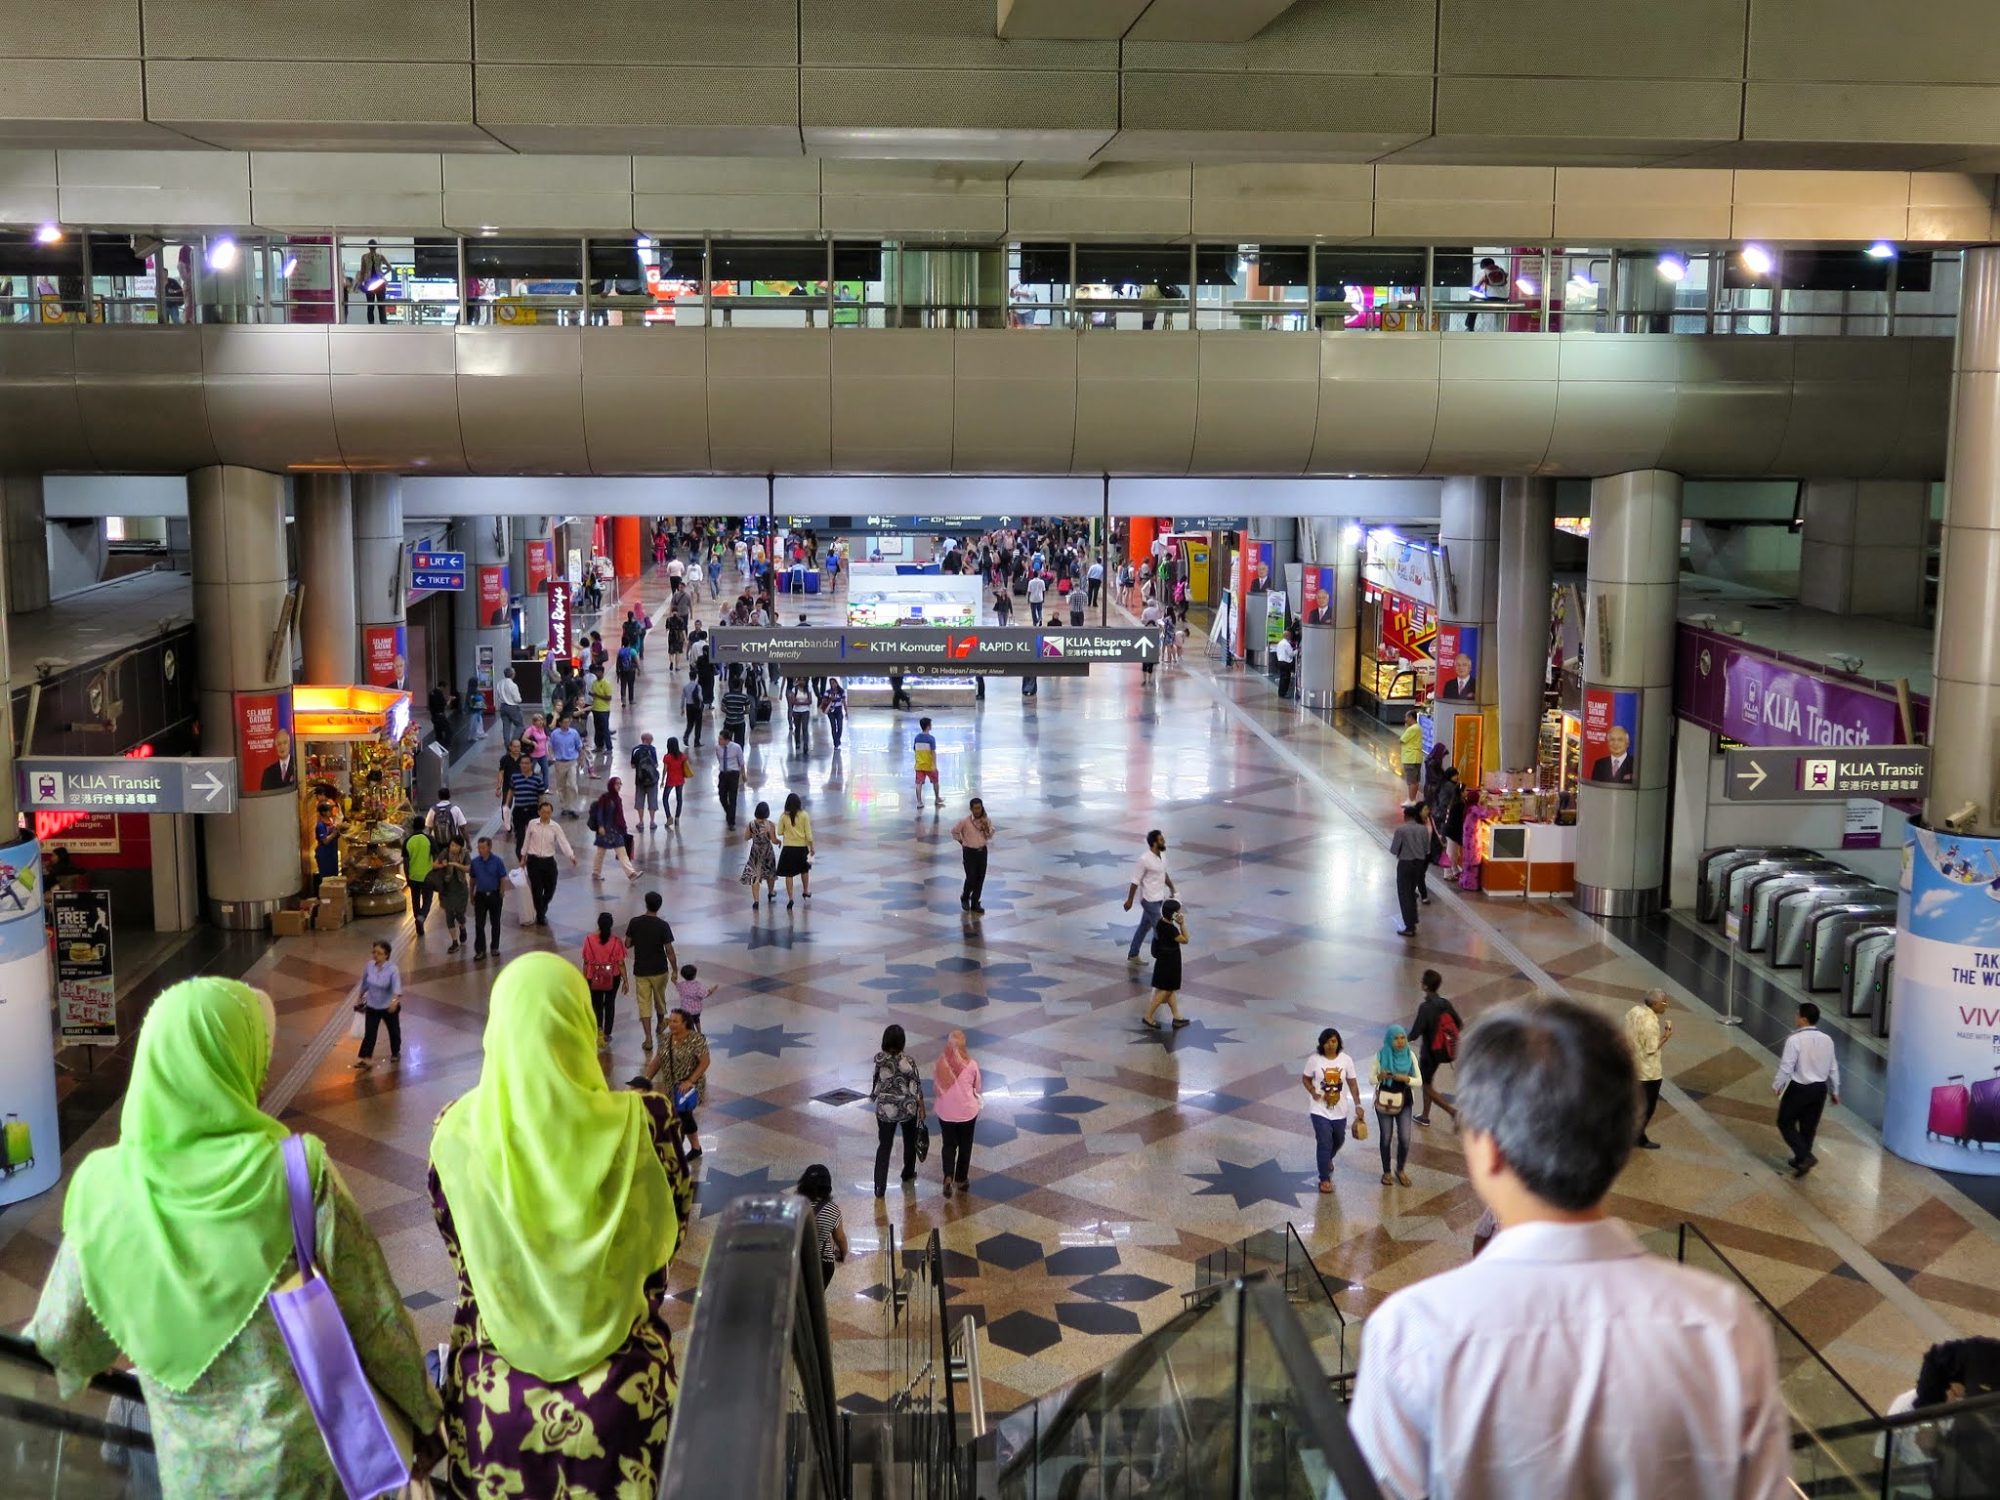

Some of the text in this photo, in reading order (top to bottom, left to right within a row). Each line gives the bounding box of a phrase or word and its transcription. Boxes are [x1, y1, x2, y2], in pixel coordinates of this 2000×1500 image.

[429, 557, 446, 566] LRT
[427, 576, 450, 584] TIKET
[741, 637, 840, 653] KTM Antarabandar
[870, 642, 946, 652] KTM Komuter
[979, 641, 1014, 652] RAPID
[1016, 641, 1031, 652] KL
[1065, 637, 1132, 649] KLIA Ekspres
[768, 650, 801, 659] Intercity
[1762, 689, 1870, 746] KLIA Transit
[1839, 762, 1925, 777] KLIA Transit
[68, 774, 162, 790] KLIA Transit
[1839, 780, 1919, 792] 空港行き普通電車
[91, 813, 112, 822] great
[74, 821, 104, 830] burger.
[57, 911, 88, 924] FREE
[1974, 952, 2000, 969] TAK
[1951, 967, 1977, 985] THE
[1959, 1005, 2000, 1028] VIV
[1956, 1031, 1975, 1040] MADE
